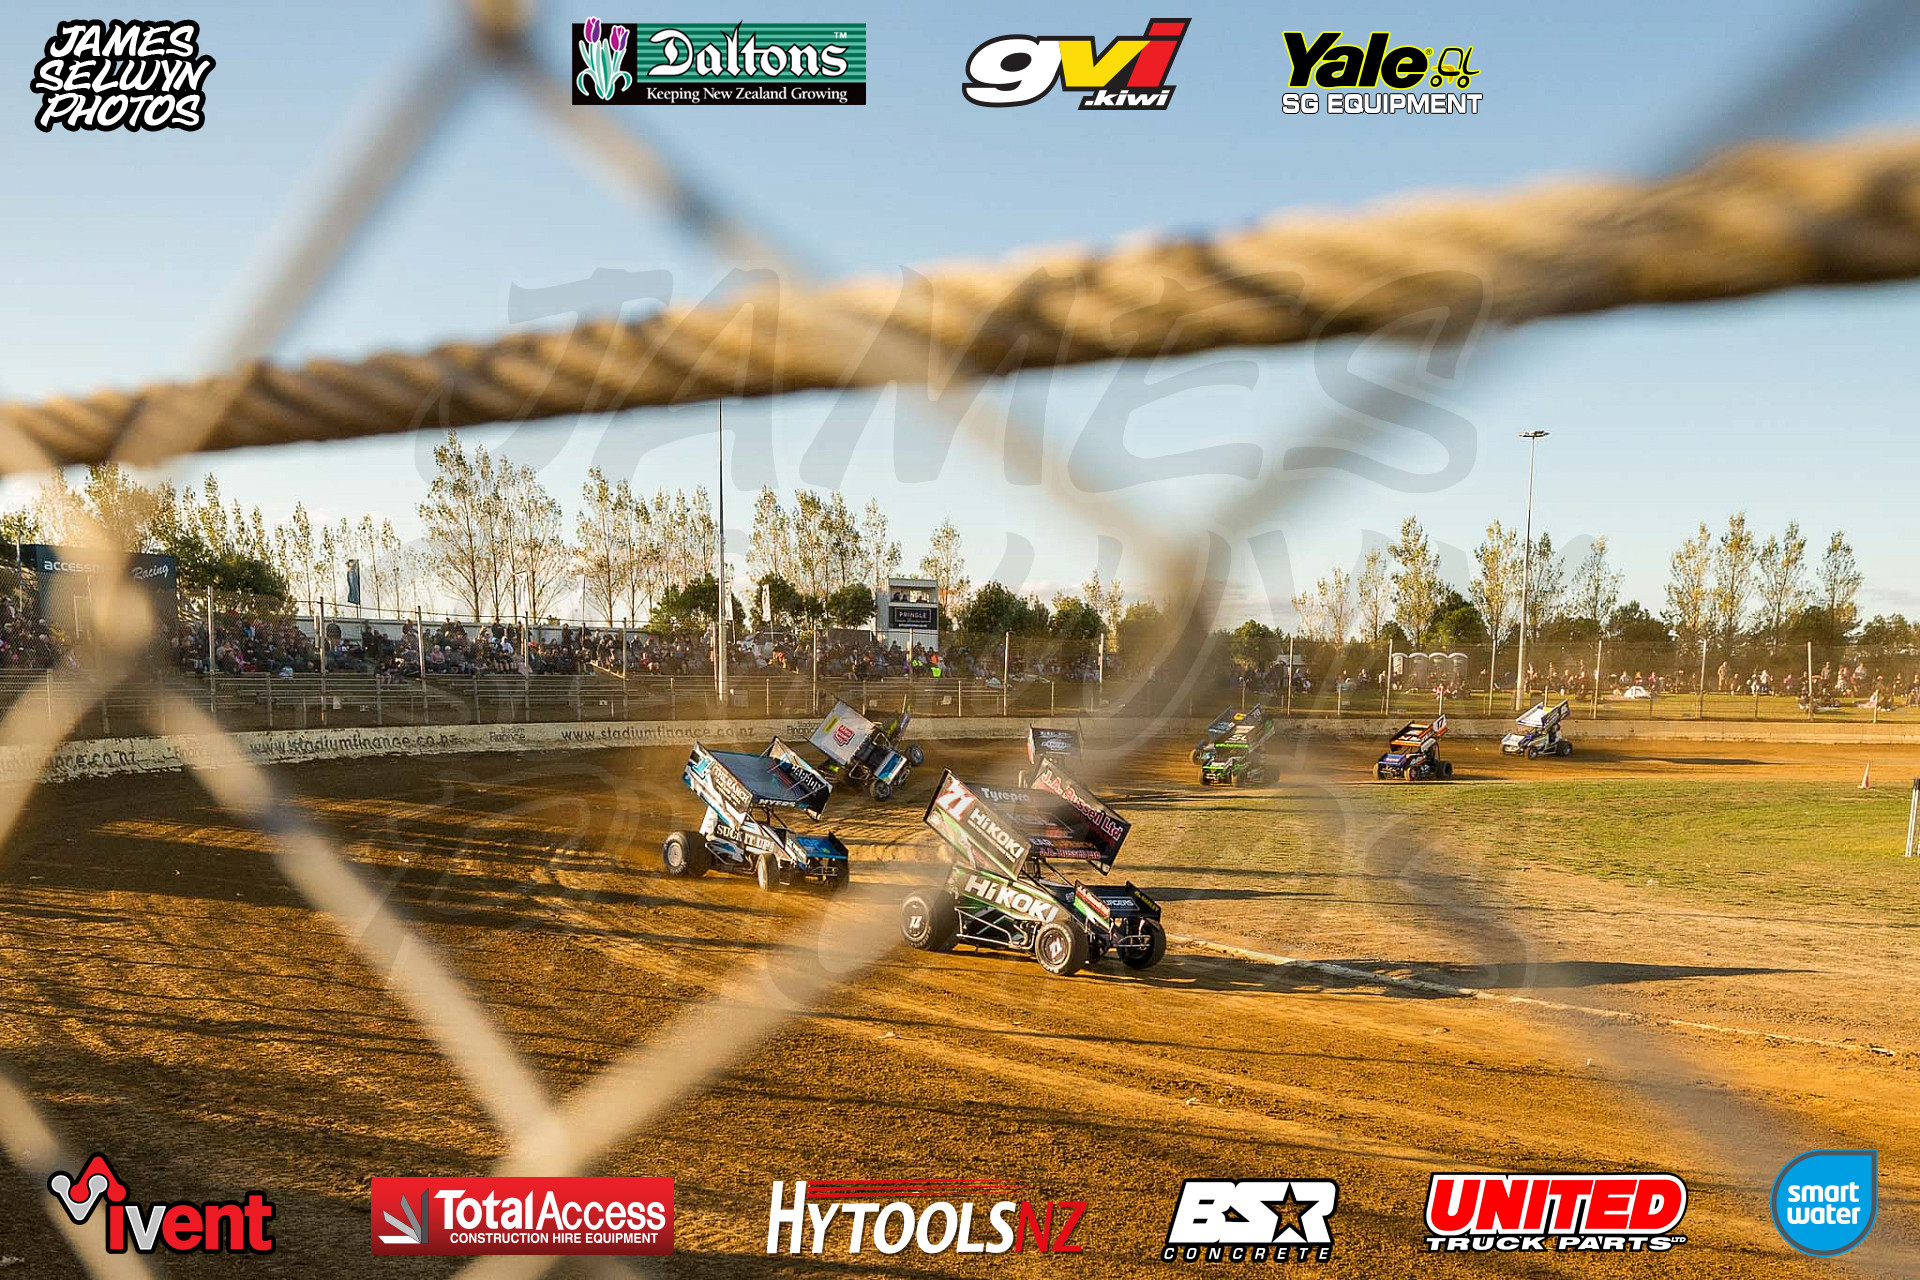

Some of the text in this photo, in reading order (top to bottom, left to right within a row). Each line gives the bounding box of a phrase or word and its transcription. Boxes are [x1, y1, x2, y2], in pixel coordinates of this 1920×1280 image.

[131, 564, 169, 580] Racing
[561, 726, 755, 742] www.stadiumfinance.co.nz
[726, 777, 750, 804] RANCH
[981, 787, 1031, 803] Tyrepro
[716, 823, 742, 842] SUCK
[744, 834, 755, 846] IT
[1101, 816, 1123, 841] Ltd
